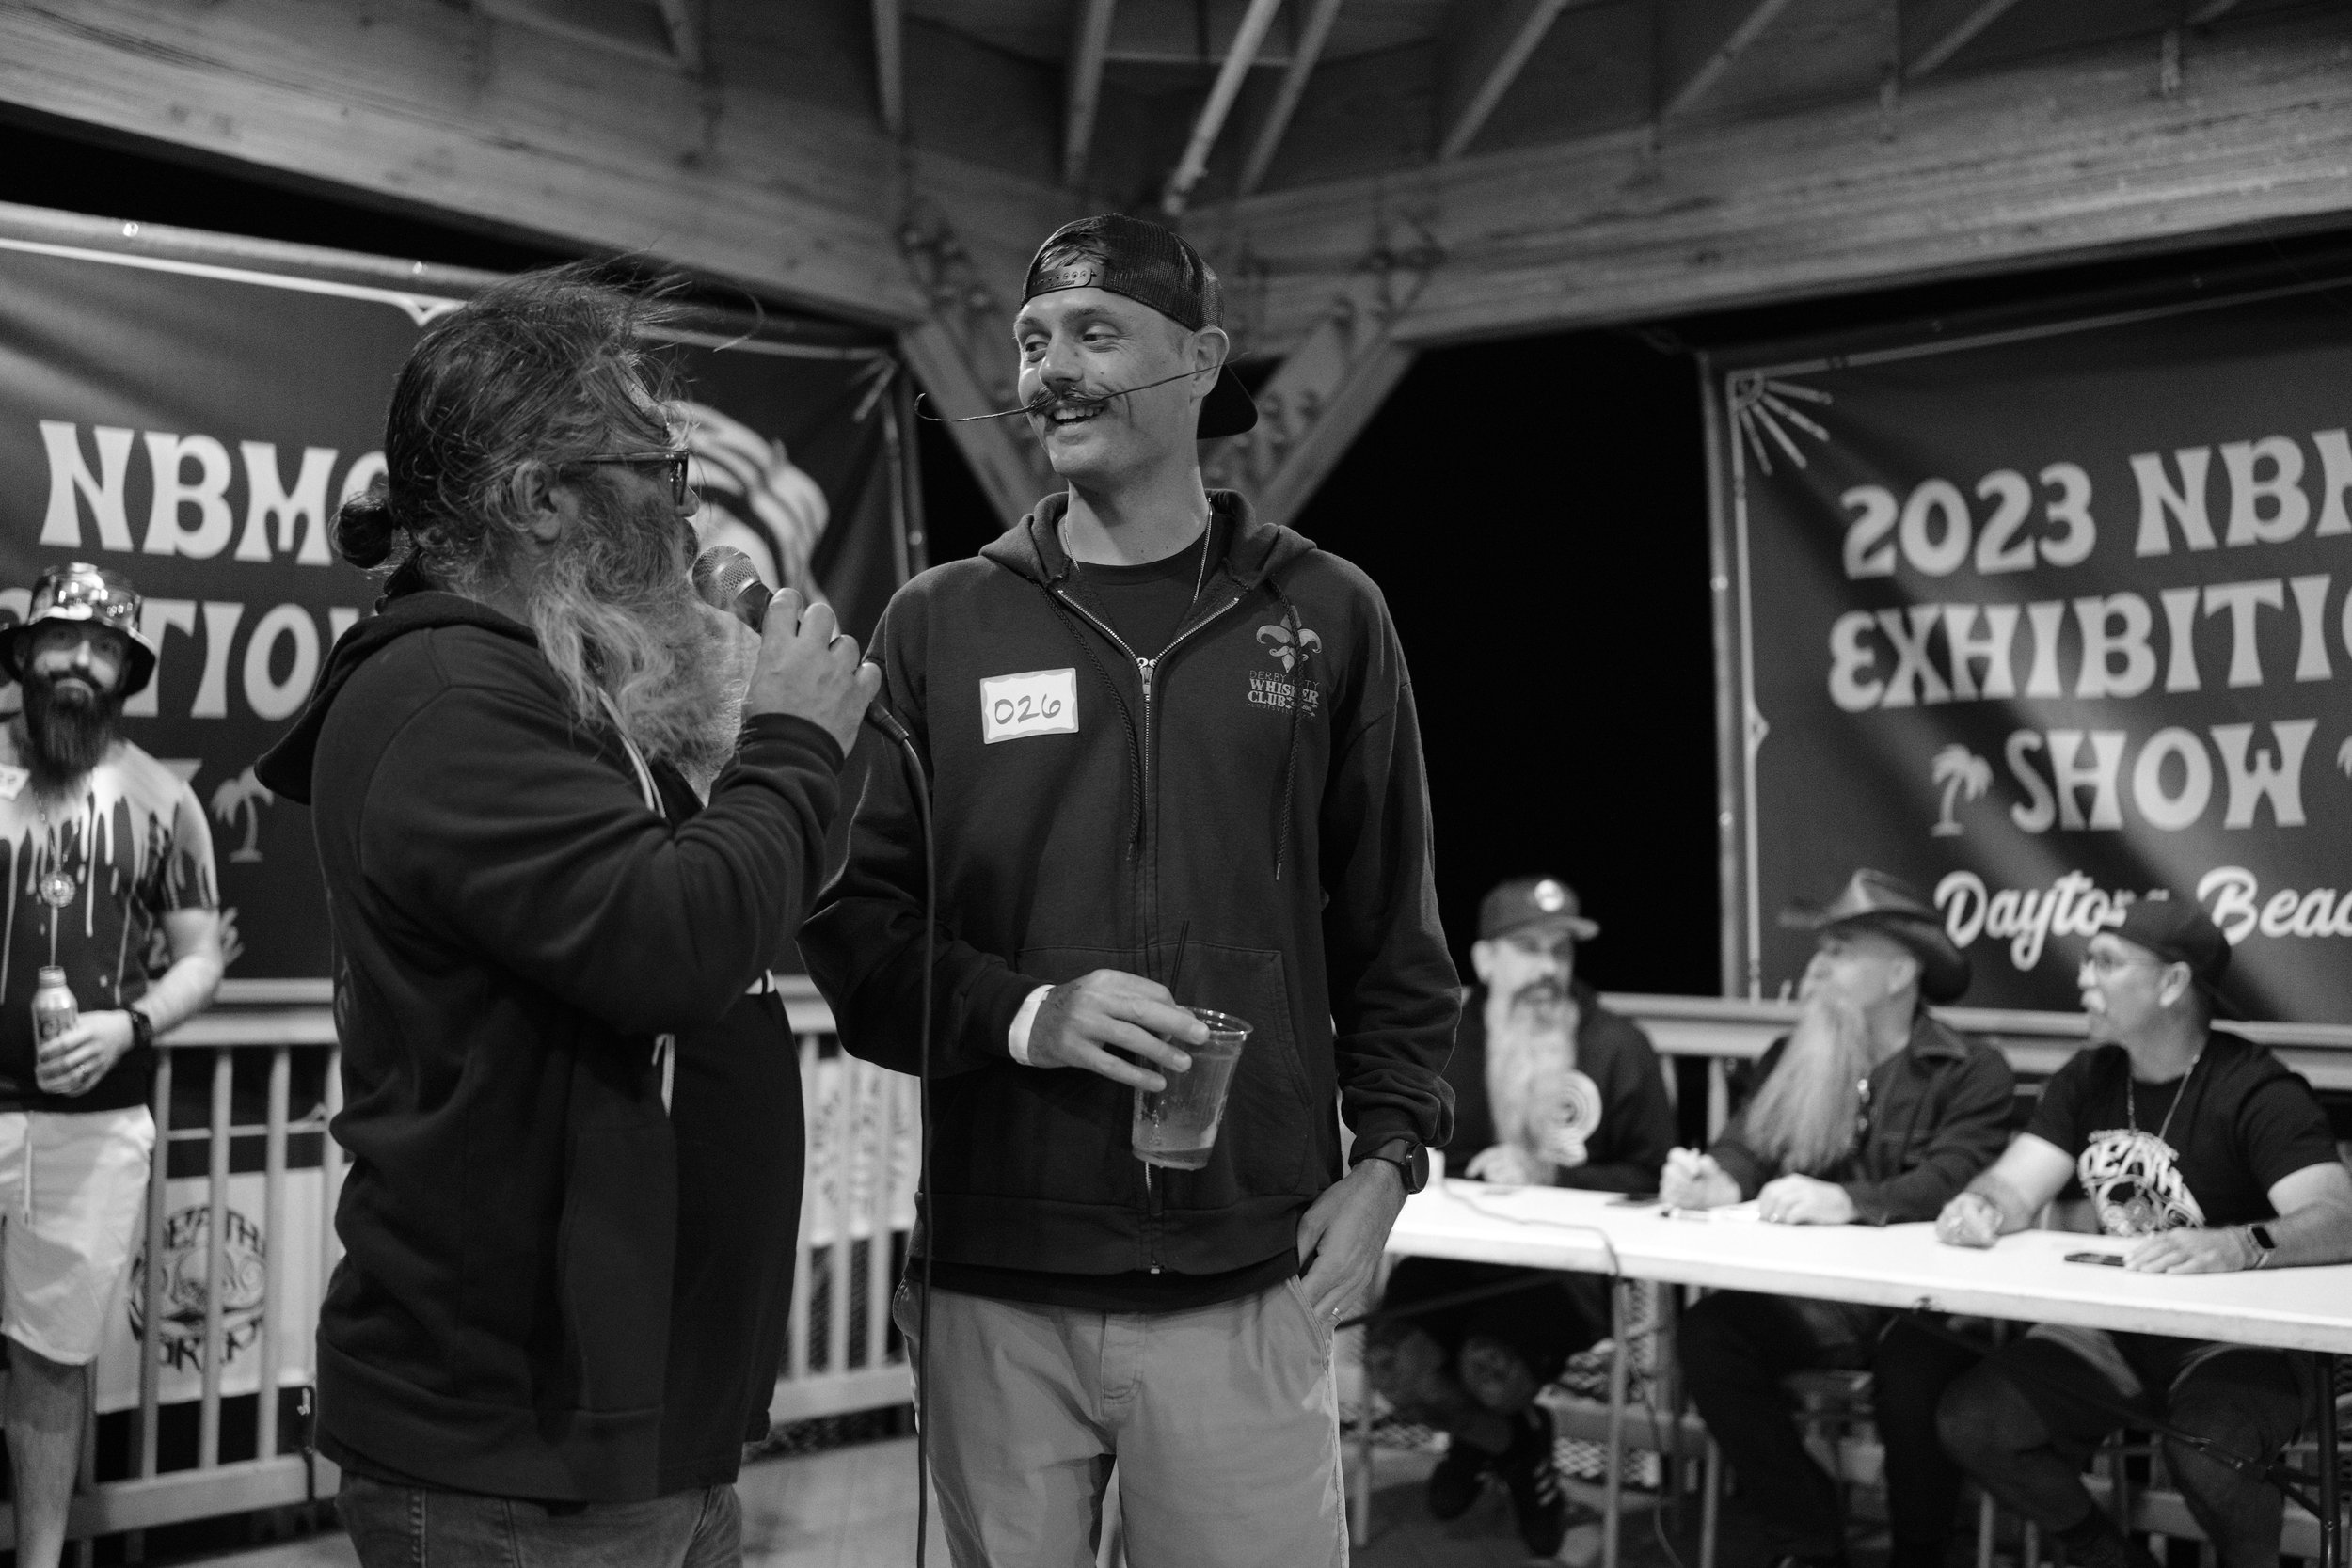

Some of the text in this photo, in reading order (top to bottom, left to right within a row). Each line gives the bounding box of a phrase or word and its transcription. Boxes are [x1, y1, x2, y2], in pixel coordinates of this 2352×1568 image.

[1841, 461, 2097, 579] 2023
[1249, 670, 1287, 684] DERBY
[1828, 573, 2352, 712] EXHIBITI
[994, 693, 1061, 725] 026
[1248, 689, 1286, 707] CLUB
[2006, 718, 2318, 833] SHOW
[1933, 869, 2169, 972] Dayto
